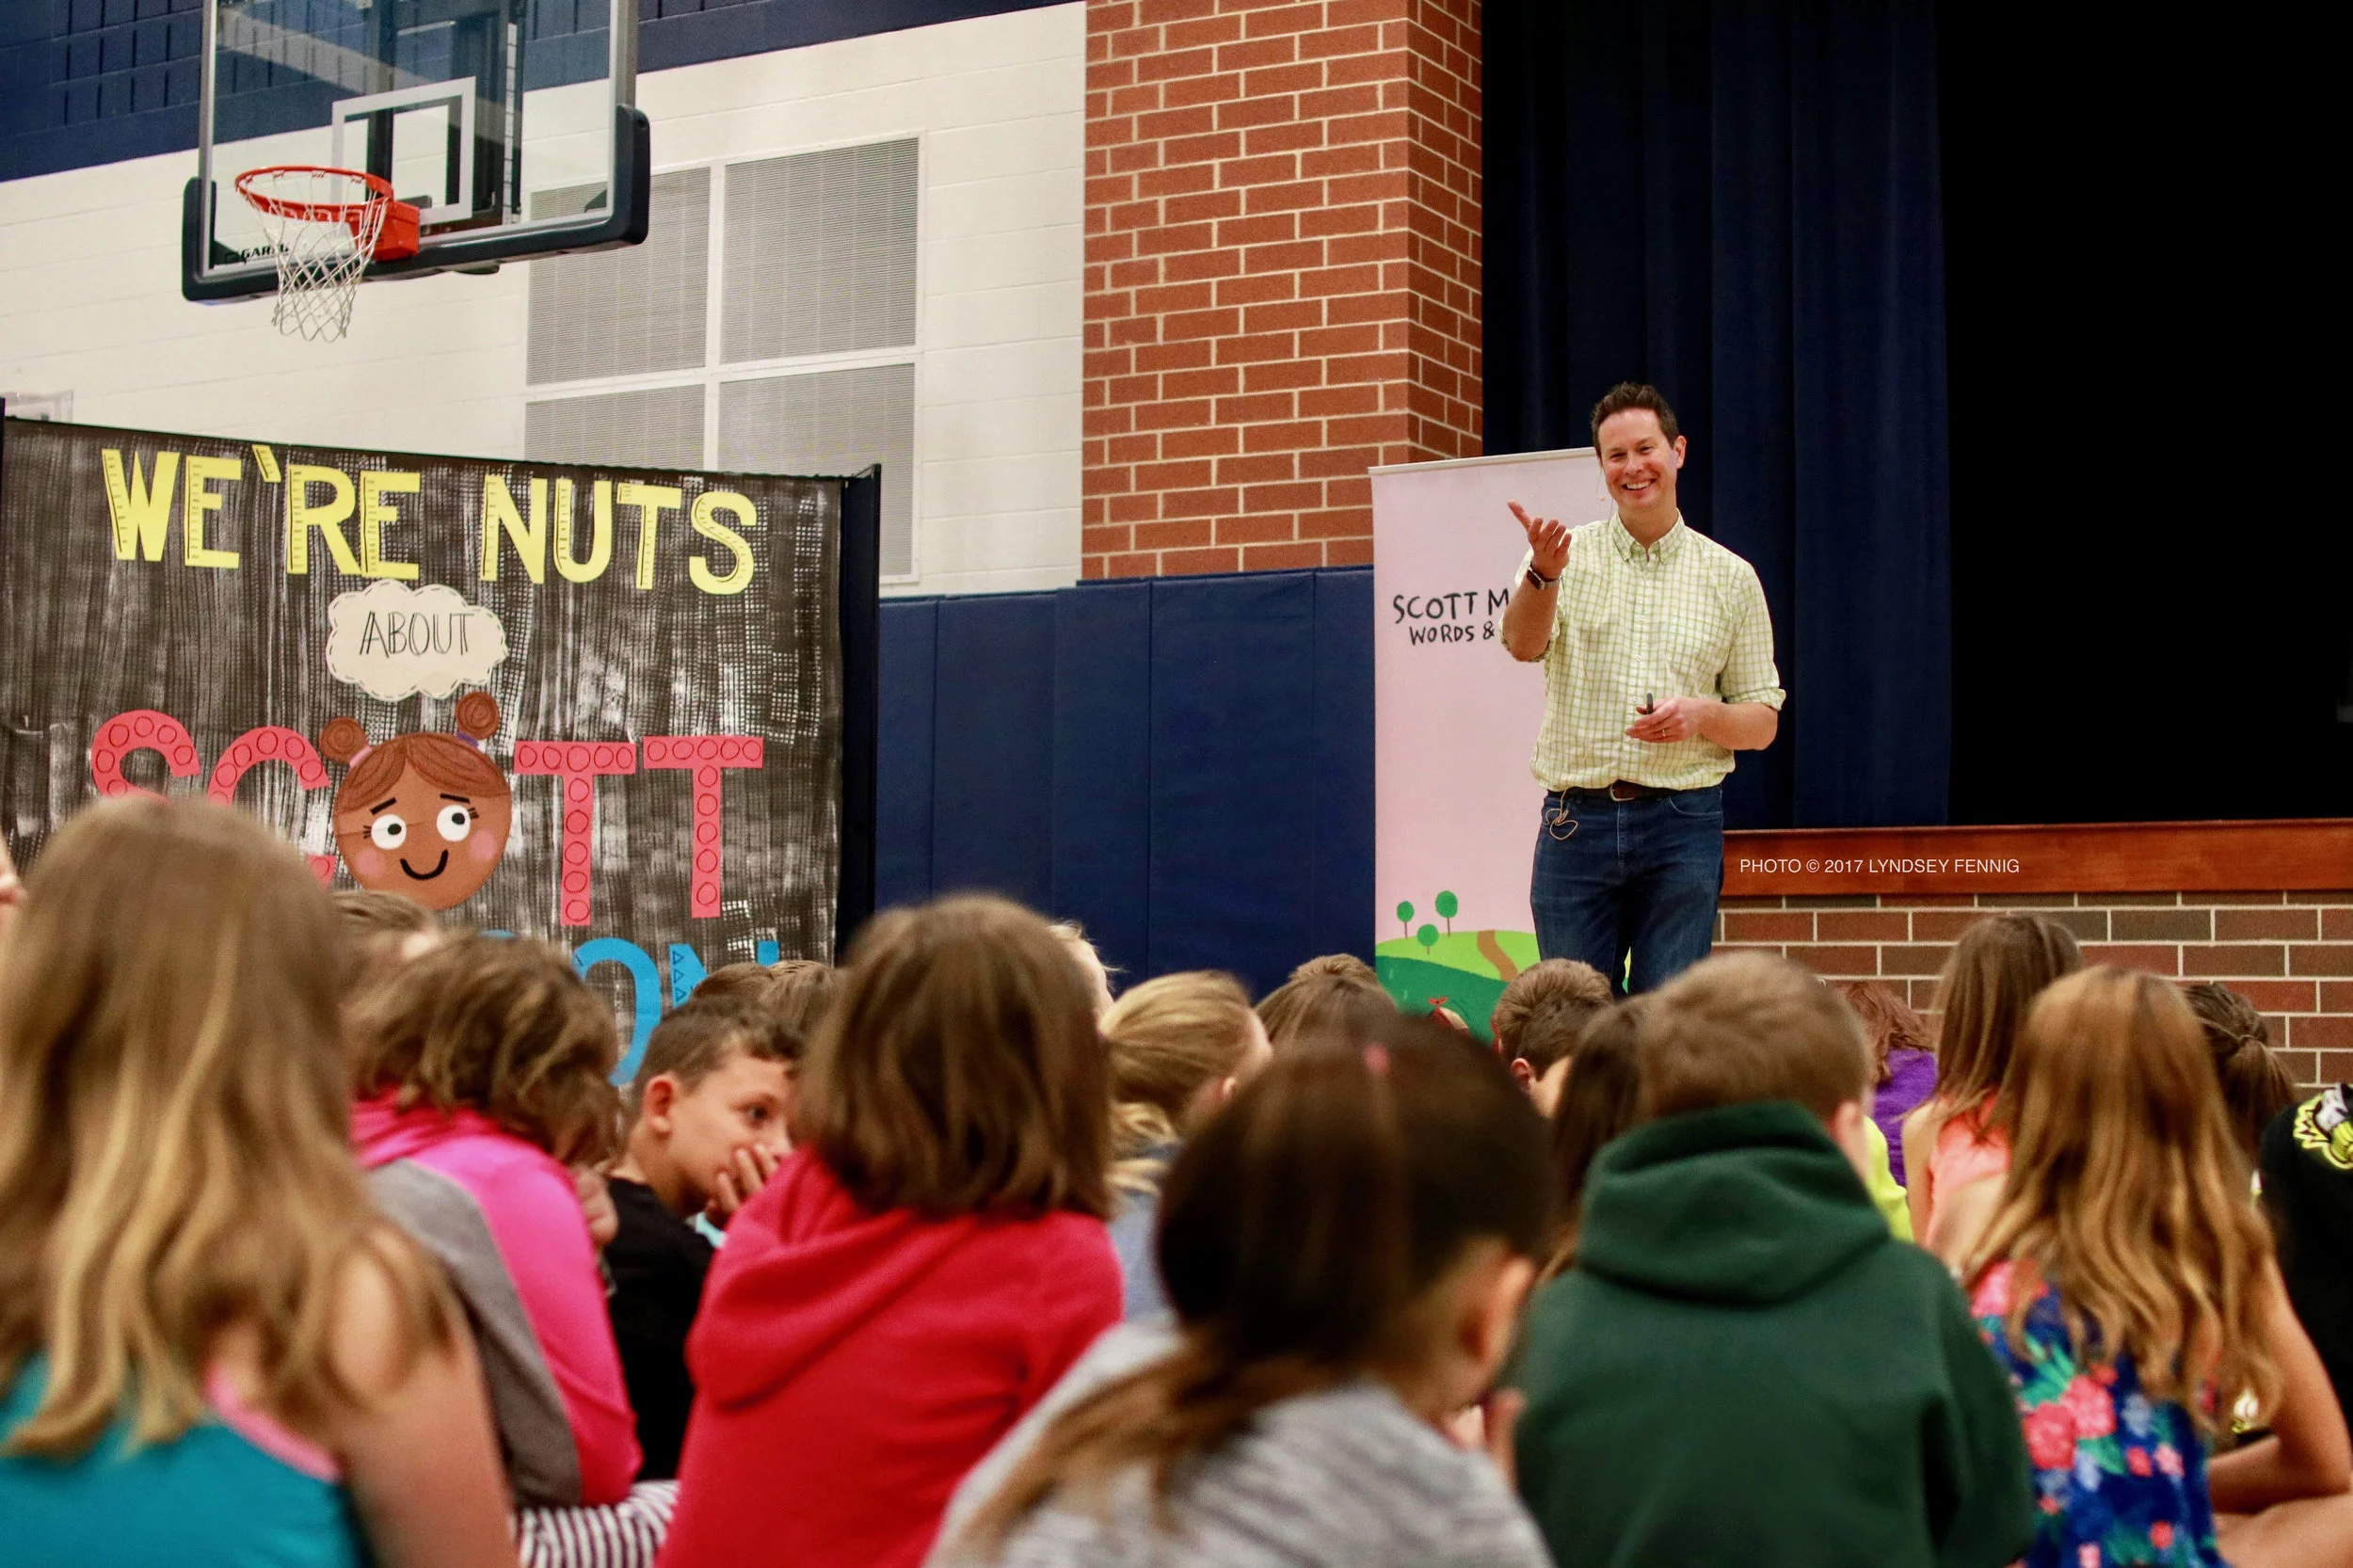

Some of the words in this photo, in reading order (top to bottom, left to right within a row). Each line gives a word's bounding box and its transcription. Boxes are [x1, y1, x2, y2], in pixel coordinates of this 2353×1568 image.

[102, 444, 422, 581] WE'RE
[480, 474, 757, 596] NUTS
[1392, 591, 1478, 624] SCOTT
[358, 610, 473, 656] ABOUT
[1409, 624, 1475, 646] WORDS
[1482, 620, 1496, 640] &
